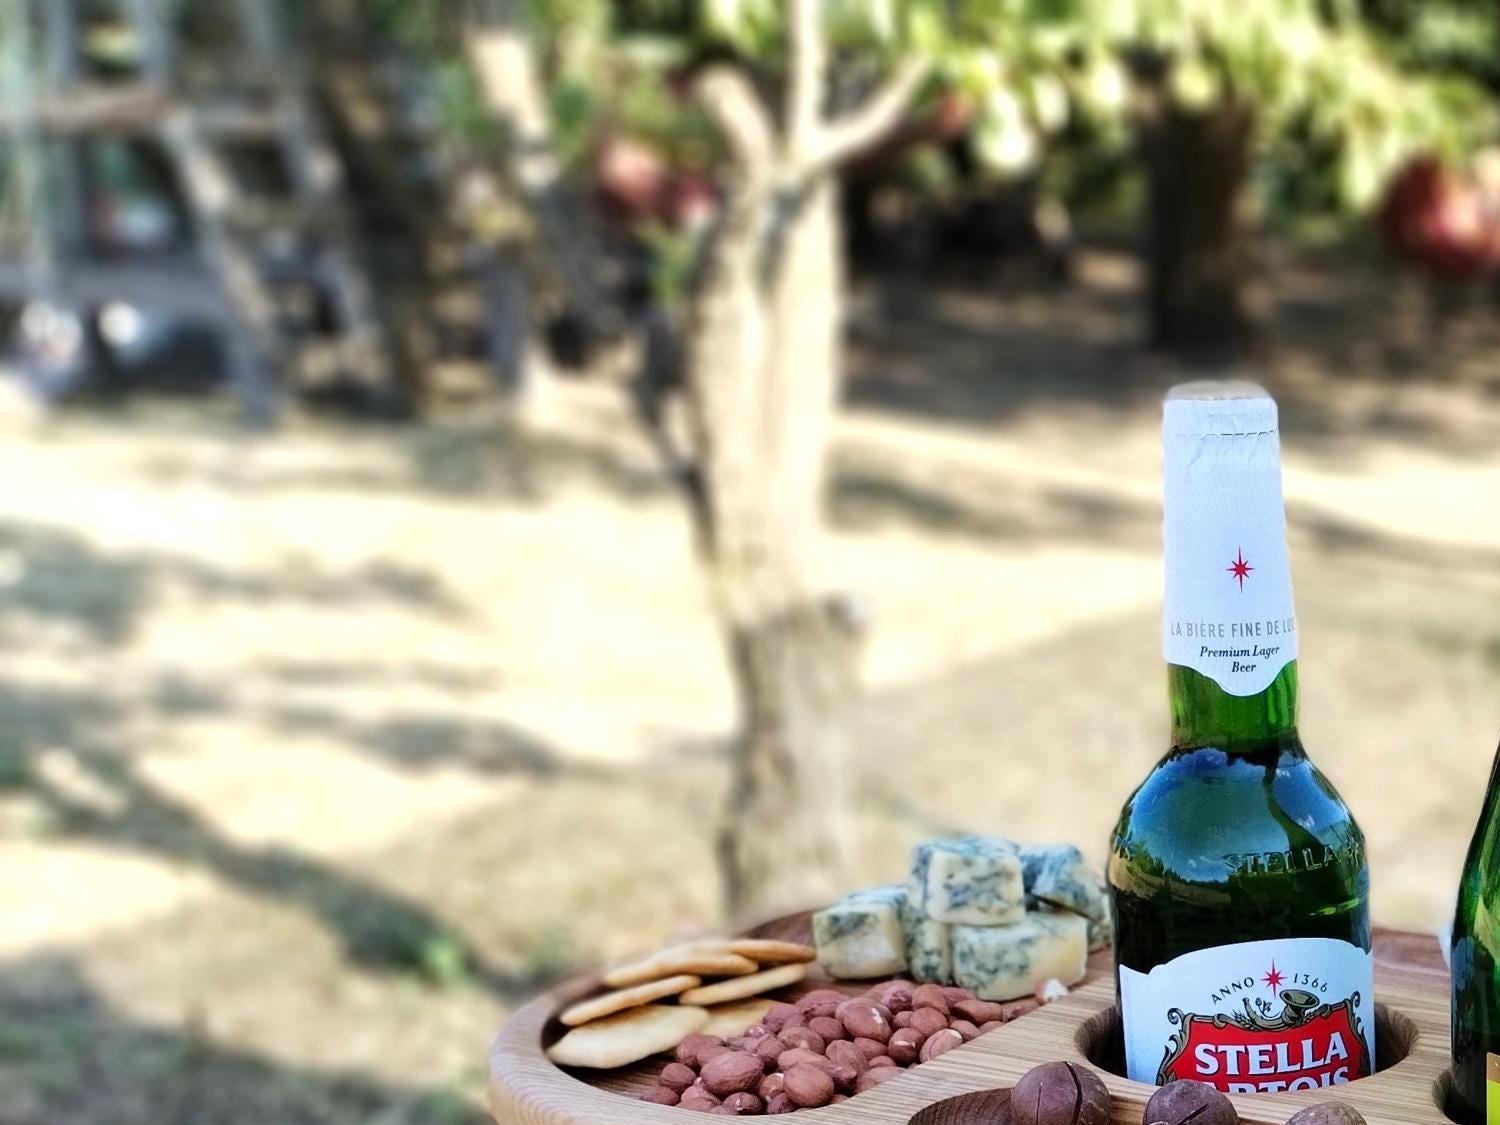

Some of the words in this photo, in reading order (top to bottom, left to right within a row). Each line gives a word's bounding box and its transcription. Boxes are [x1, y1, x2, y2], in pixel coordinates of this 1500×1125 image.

[1170, 621, 1183, 637] LA
[1186, 619, 1226, 638] BIÈRE
[1231, 622, 1262, 638] FINE
[1266, 620, 1280, 636] DE
[1198, 645, 1251, 658] Premium
[1252, 644, 1281, 660] Lager
[1231, 661, 1257, 673] Beer
[1210, 976, 1255, 1005] ANNO
[1293, 972, 1329, 993] 1366
[1194, 1030, 1349, 1076] STELLA
